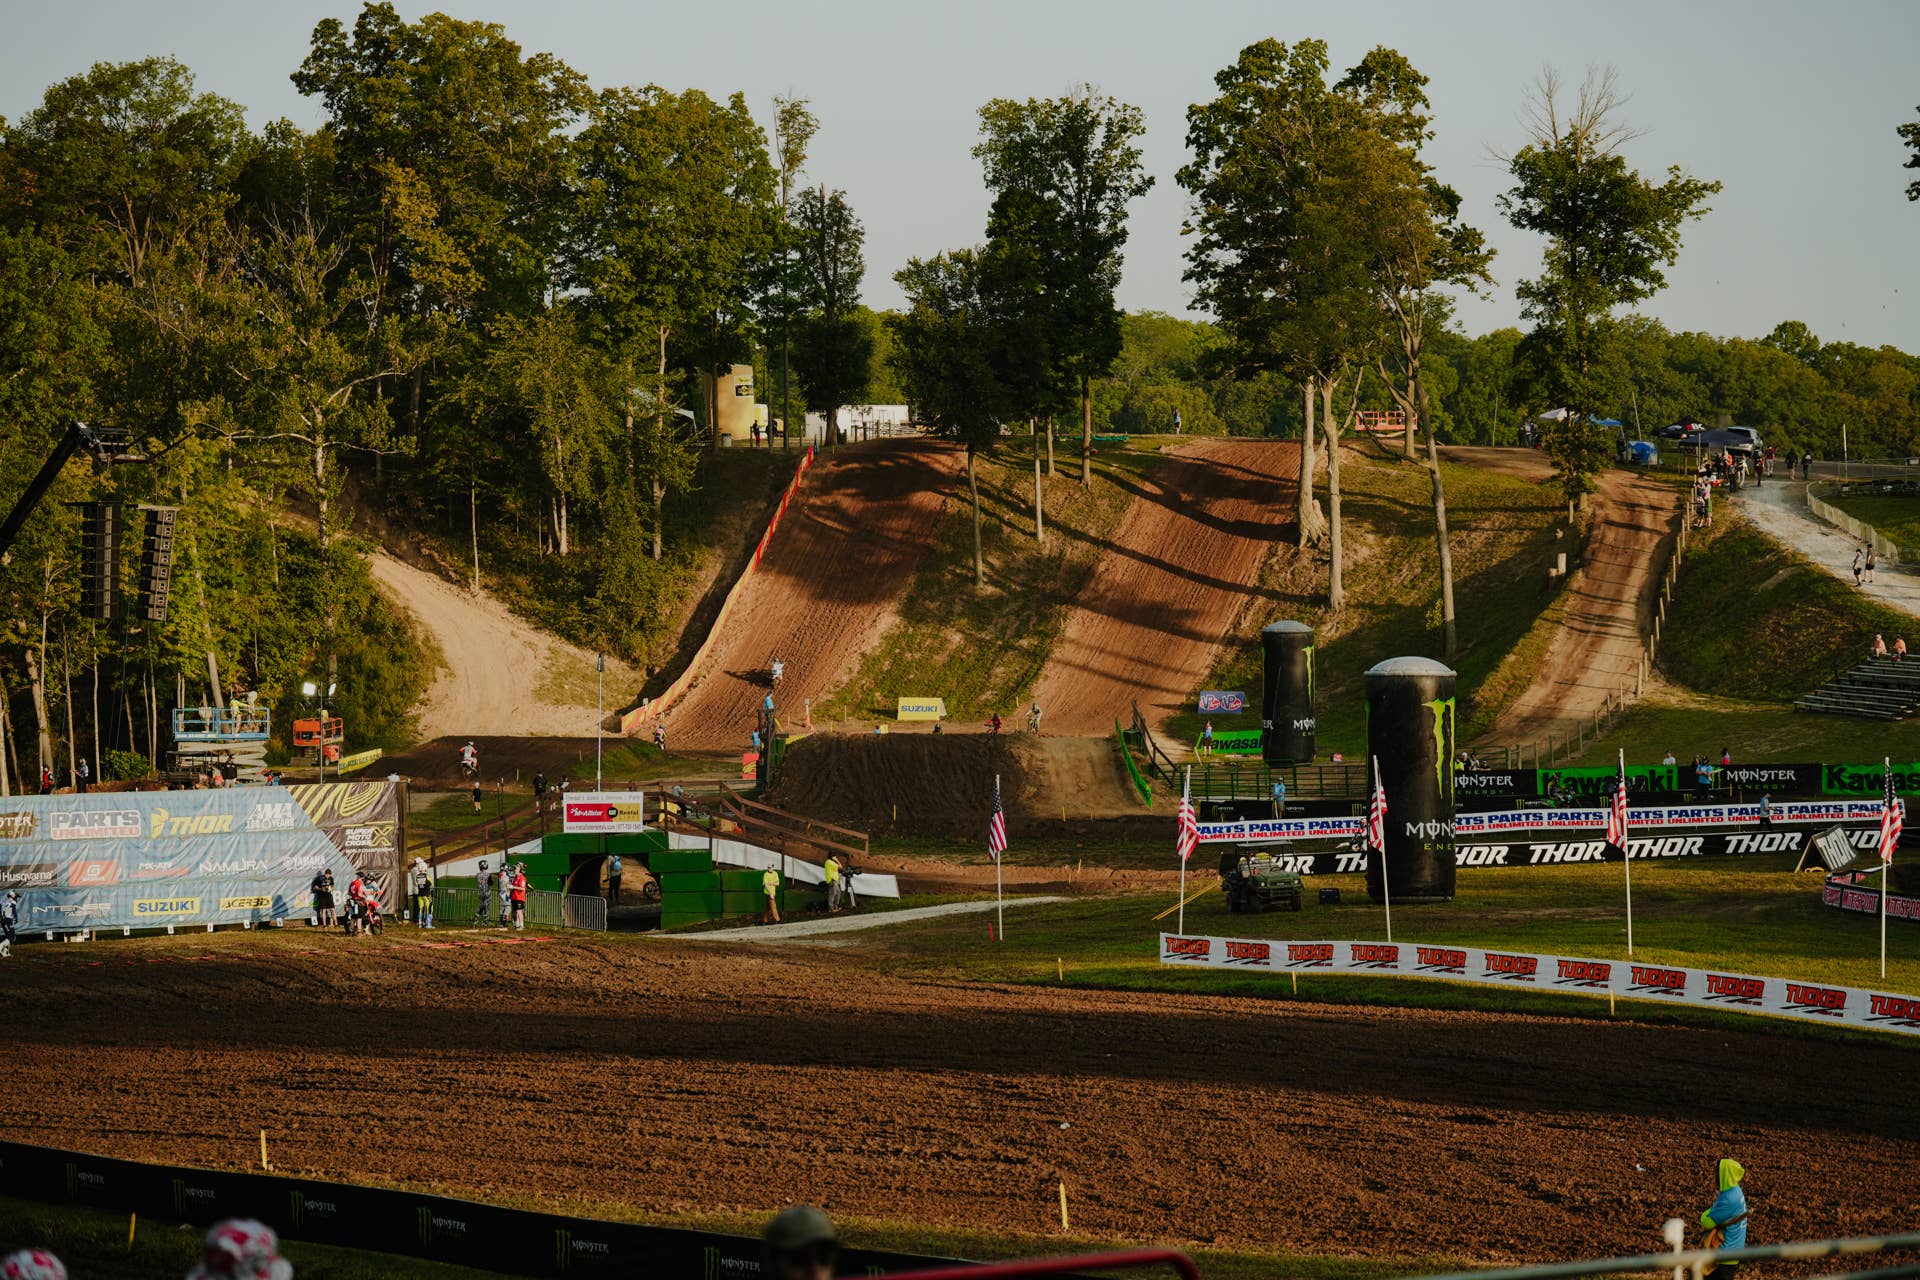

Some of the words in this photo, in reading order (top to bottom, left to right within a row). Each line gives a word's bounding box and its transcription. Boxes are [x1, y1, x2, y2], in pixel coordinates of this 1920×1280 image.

[901, 705, 938, 713] SUZUKI
[1199, 736, 1263, 751] awasa
[1542, 769, 1674, 796] Kawaki
[1727, 768, 1797, 783] MONSTER
[1668, 808, 1724, 818] PARTS
[1728, 806, 1784, 816] PARS
[1788, 804, 1843, 815] PARTS
[1848, 802, 1903, 813] PAR
[52, 811, 139, 828] PARTS
[1488, 812, 1542, 824] PARTS
[1547, 811, 1604, 821] PARTS
[1547, 819, 1604, 827] UNLIMITED
[1668, 816, 1724, 824] UNLIMITED
[1728, 814, 1784, 822] UNLIMED
[1788, 812, 1844, 820] UNLIMITED
[52, 826, 140, 838] UNLIMITED
[169, 814, 234, 836] THOR
[346, 828, 373, 836] SUPER
[1249, 822, 1305, 833] PARTS
[1308, 819, 1361, 831] PARTS
[1309, 828, 1366, 836] UNLIMITED
[1488, 821, 1543, 829] UNLIMITED
[1249, 830, 1305, 838] UNLIMITED
[1423, 843, 1456, 851] ENE
[1628, 836, 1705, 858] THOR
[1725, 832, 1803, 855] THOR
[1816, 827, 1856, 870] THOR
[1528, 841, 1606, 864] THOR
[199, 859, 267, 874] NAMURA
[292, 855, 325, 868] YAMAHA
[2, 871, 52, 883] Husqvarna
[32, 902, 111, 913] INTENSE
[138, 900, 194, 913] SUZUKI
[1165, 937, 1211, 955] TUCKER
[1225, 941, 1270, 959] TUCKER
[1287, 944, 1334, 961] TUCKER
[1350, 944, 1399, 962] TUCKER
[1416, 947, 1467, 968] TUCKER
[1485, 953, 1538, 975] TUCKER
[1557, 959, 1611, 981] TUCKER
[1630, 966, 1687, 989] TUCKER
[1706, 974, 1765, 998] TUCKER
[1786, 983, 1847, 1010] TUCKER
[431, 1216, 467, 1232] MONSTER
[571, 1239, 609, 1255] MONSTER
[720, 1255, 761, 1274] MONSTER
